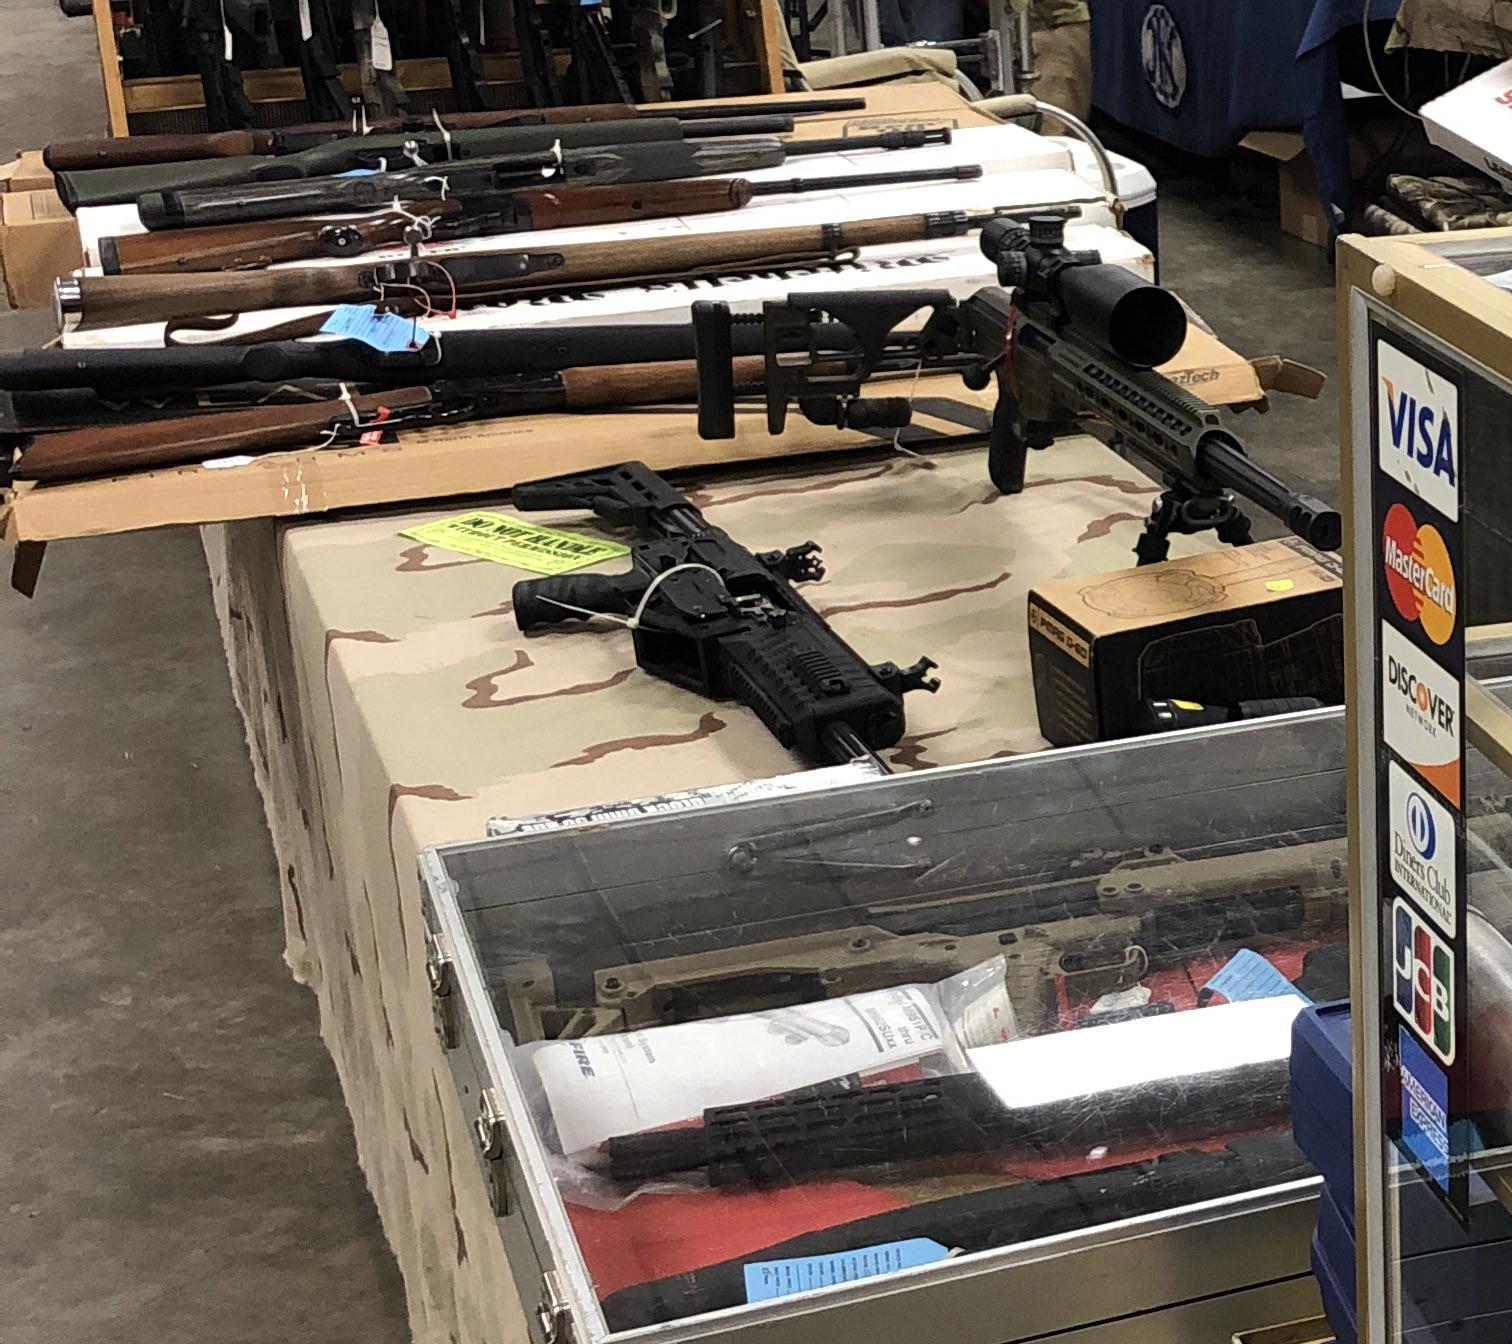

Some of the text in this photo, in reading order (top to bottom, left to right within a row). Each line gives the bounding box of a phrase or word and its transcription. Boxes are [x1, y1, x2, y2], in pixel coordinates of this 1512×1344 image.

[1381, 376, 1456, 487] VISA
[1384, 535, 1455, 614] MasterCard
[1388, 654, 1455, 737] DISCOVER
[1394, 830, 1451, 905] Diners Club
[1394, 857, 1452, 926] INTERNATIONAL
[1396, 941, 1450, 1024] JCB
[1401, 1064, 1448, 1134] AMERICAN
[1409, 1096, 1449, 1159] EXPRESS
